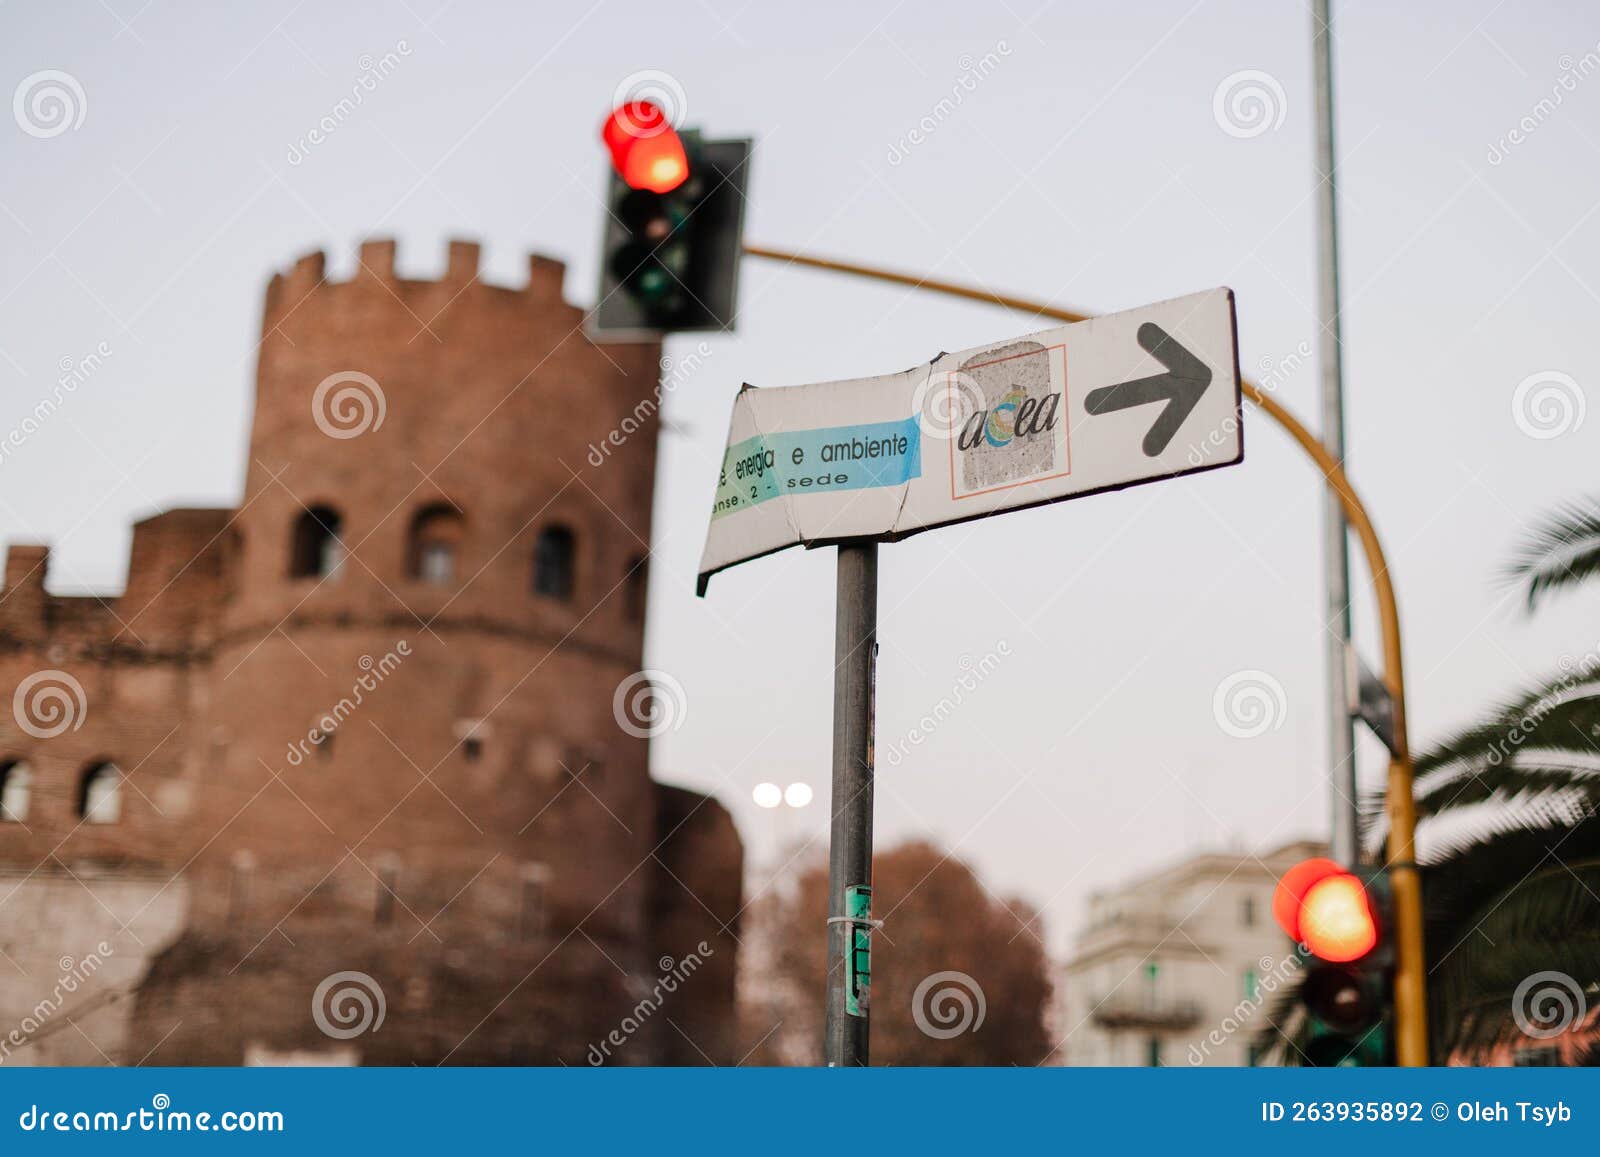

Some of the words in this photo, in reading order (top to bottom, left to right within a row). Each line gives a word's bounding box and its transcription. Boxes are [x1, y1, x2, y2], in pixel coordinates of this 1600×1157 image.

[958, 391, 1061, 451] acea
[735, 446, 775, 480] energia
[791, 447, 804, 465] e
[820, 434, 908, 463] ambiente
[750, 485, 758, 499] 2
[787, 473, 849, 488] sede
